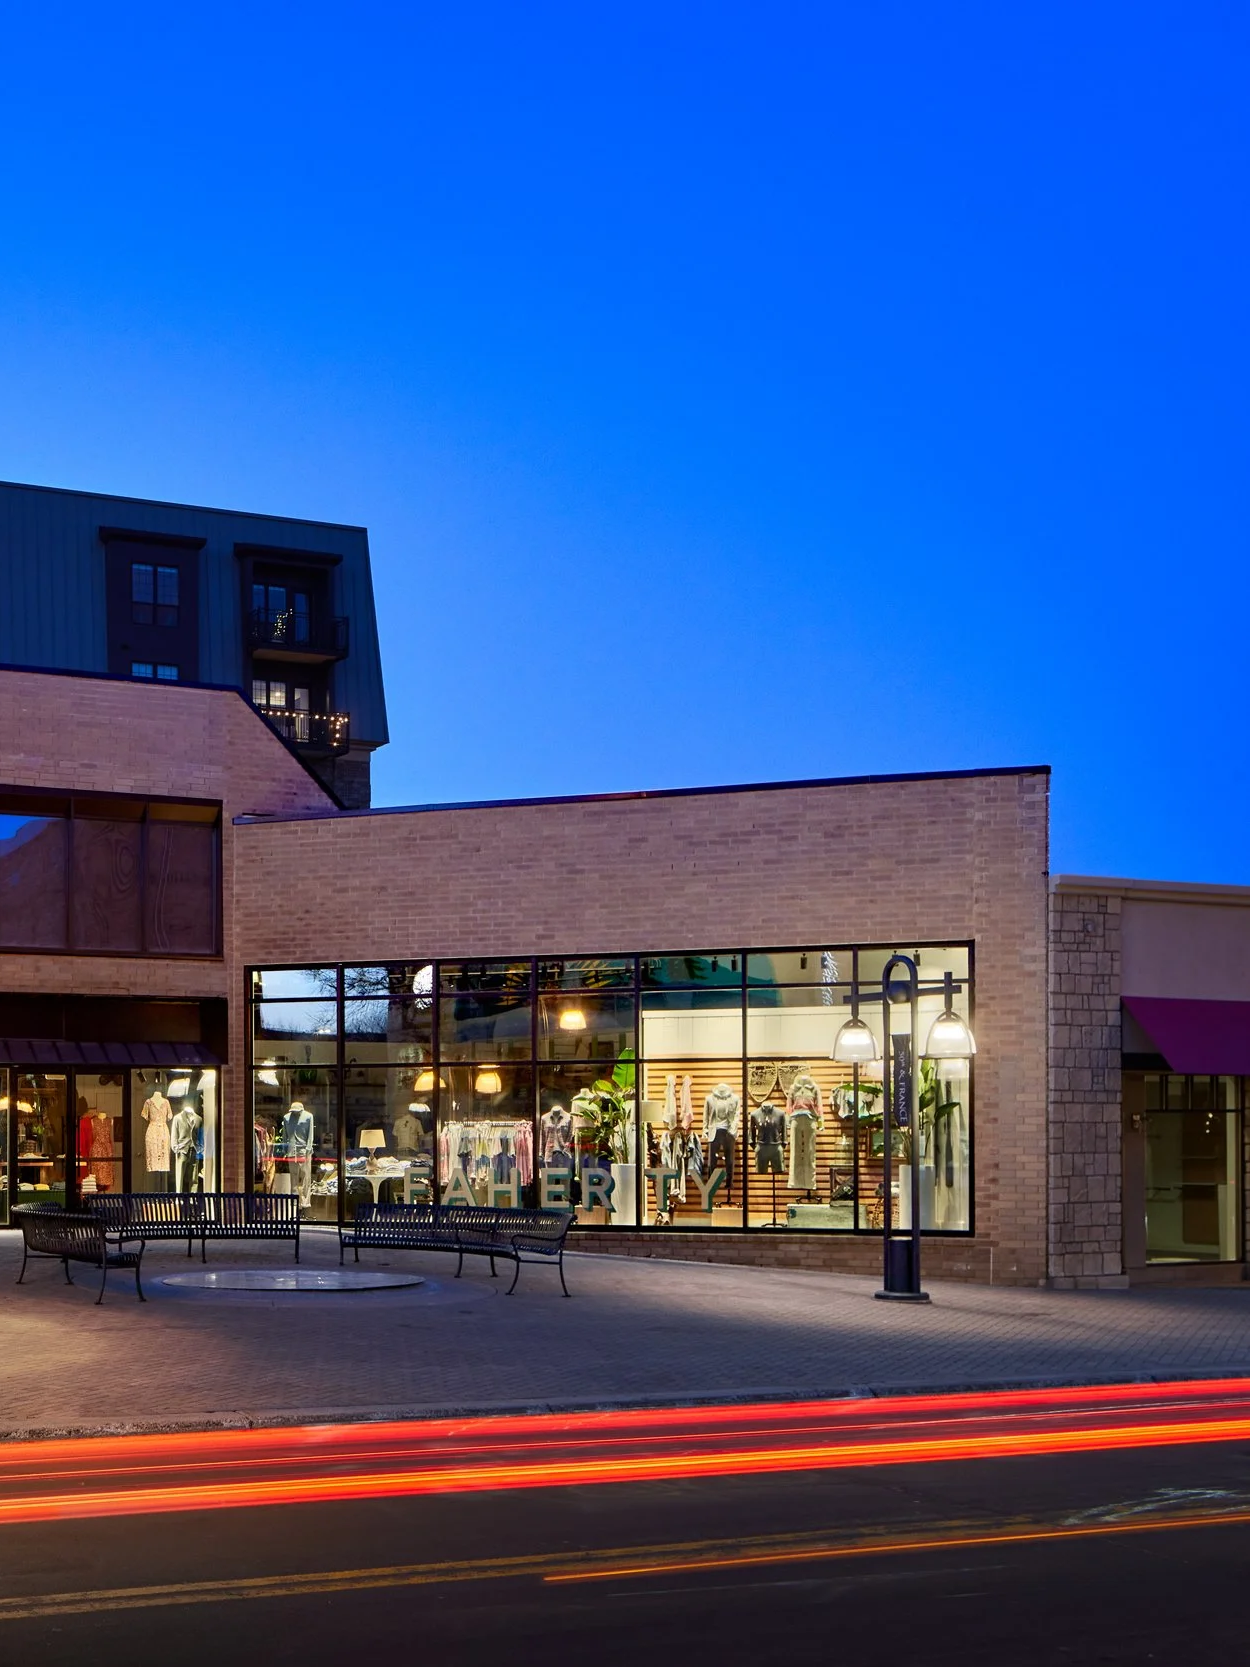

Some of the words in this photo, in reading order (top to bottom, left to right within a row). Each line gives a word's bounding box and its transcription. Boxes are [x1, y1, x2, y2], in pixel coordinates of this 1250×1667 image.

[898, 1069, 906, 1080] &
[898, 1082, 908, 1123] FRANCE
[403, 1167, 727, 1212] FAHERTY
